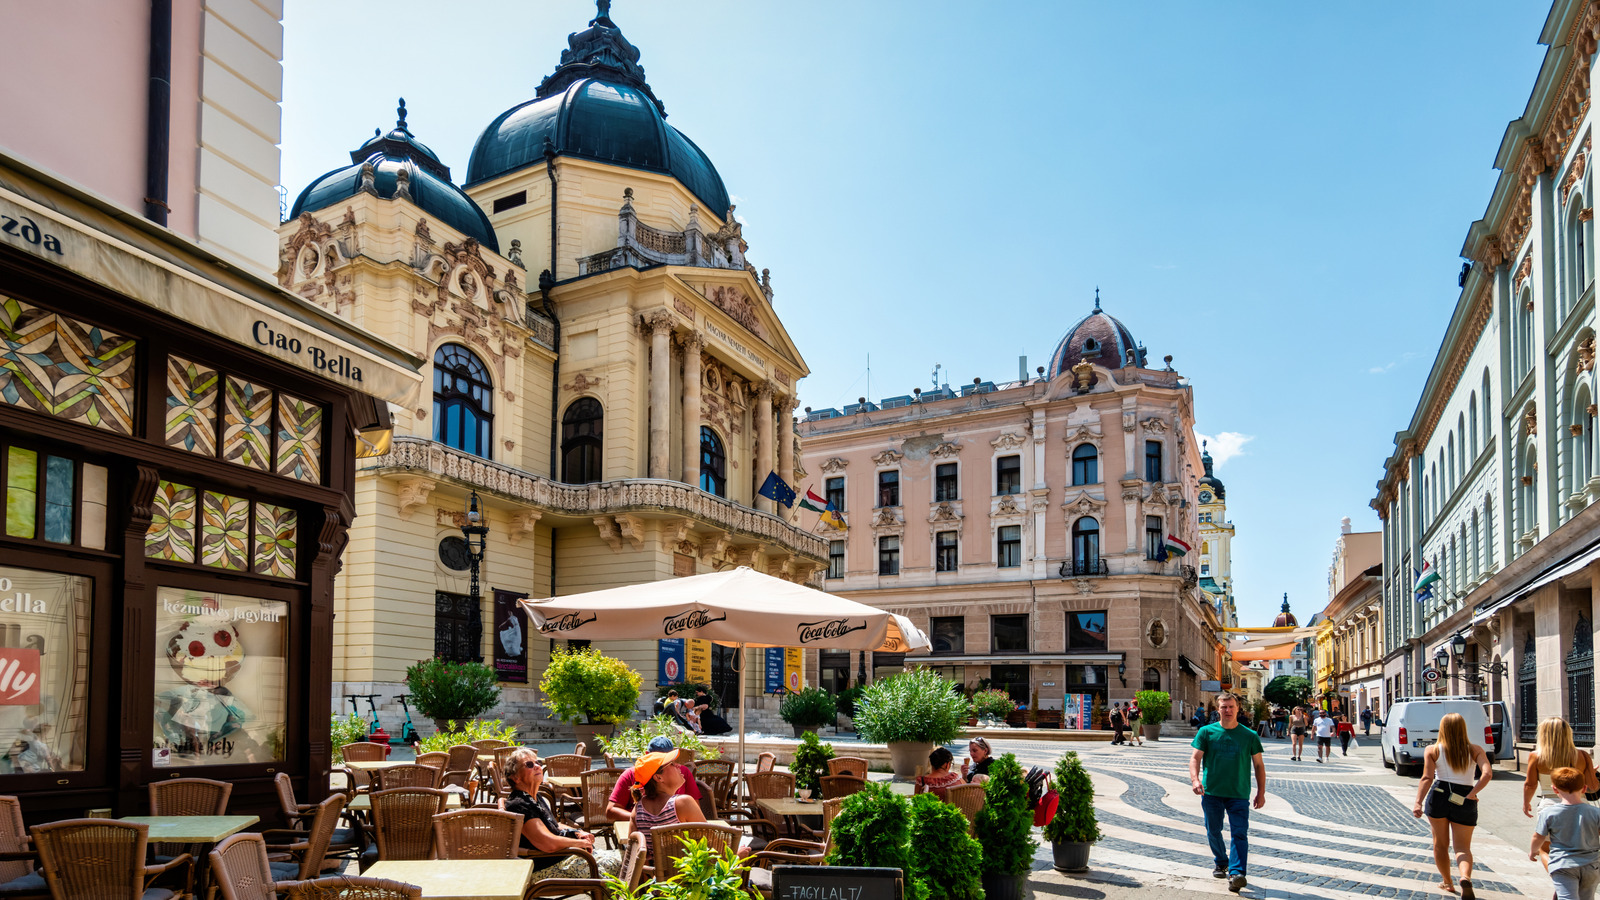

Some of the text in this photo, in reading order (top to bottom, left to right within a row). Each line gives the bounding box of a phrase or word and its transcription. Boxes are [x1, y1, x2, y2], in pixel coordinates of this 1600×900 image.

[252, 320, 363, 382] Ciao Bella
[662, 609, 726, 635] Coca-Cola
[797, 618, 867, 643] Coca-Cola
